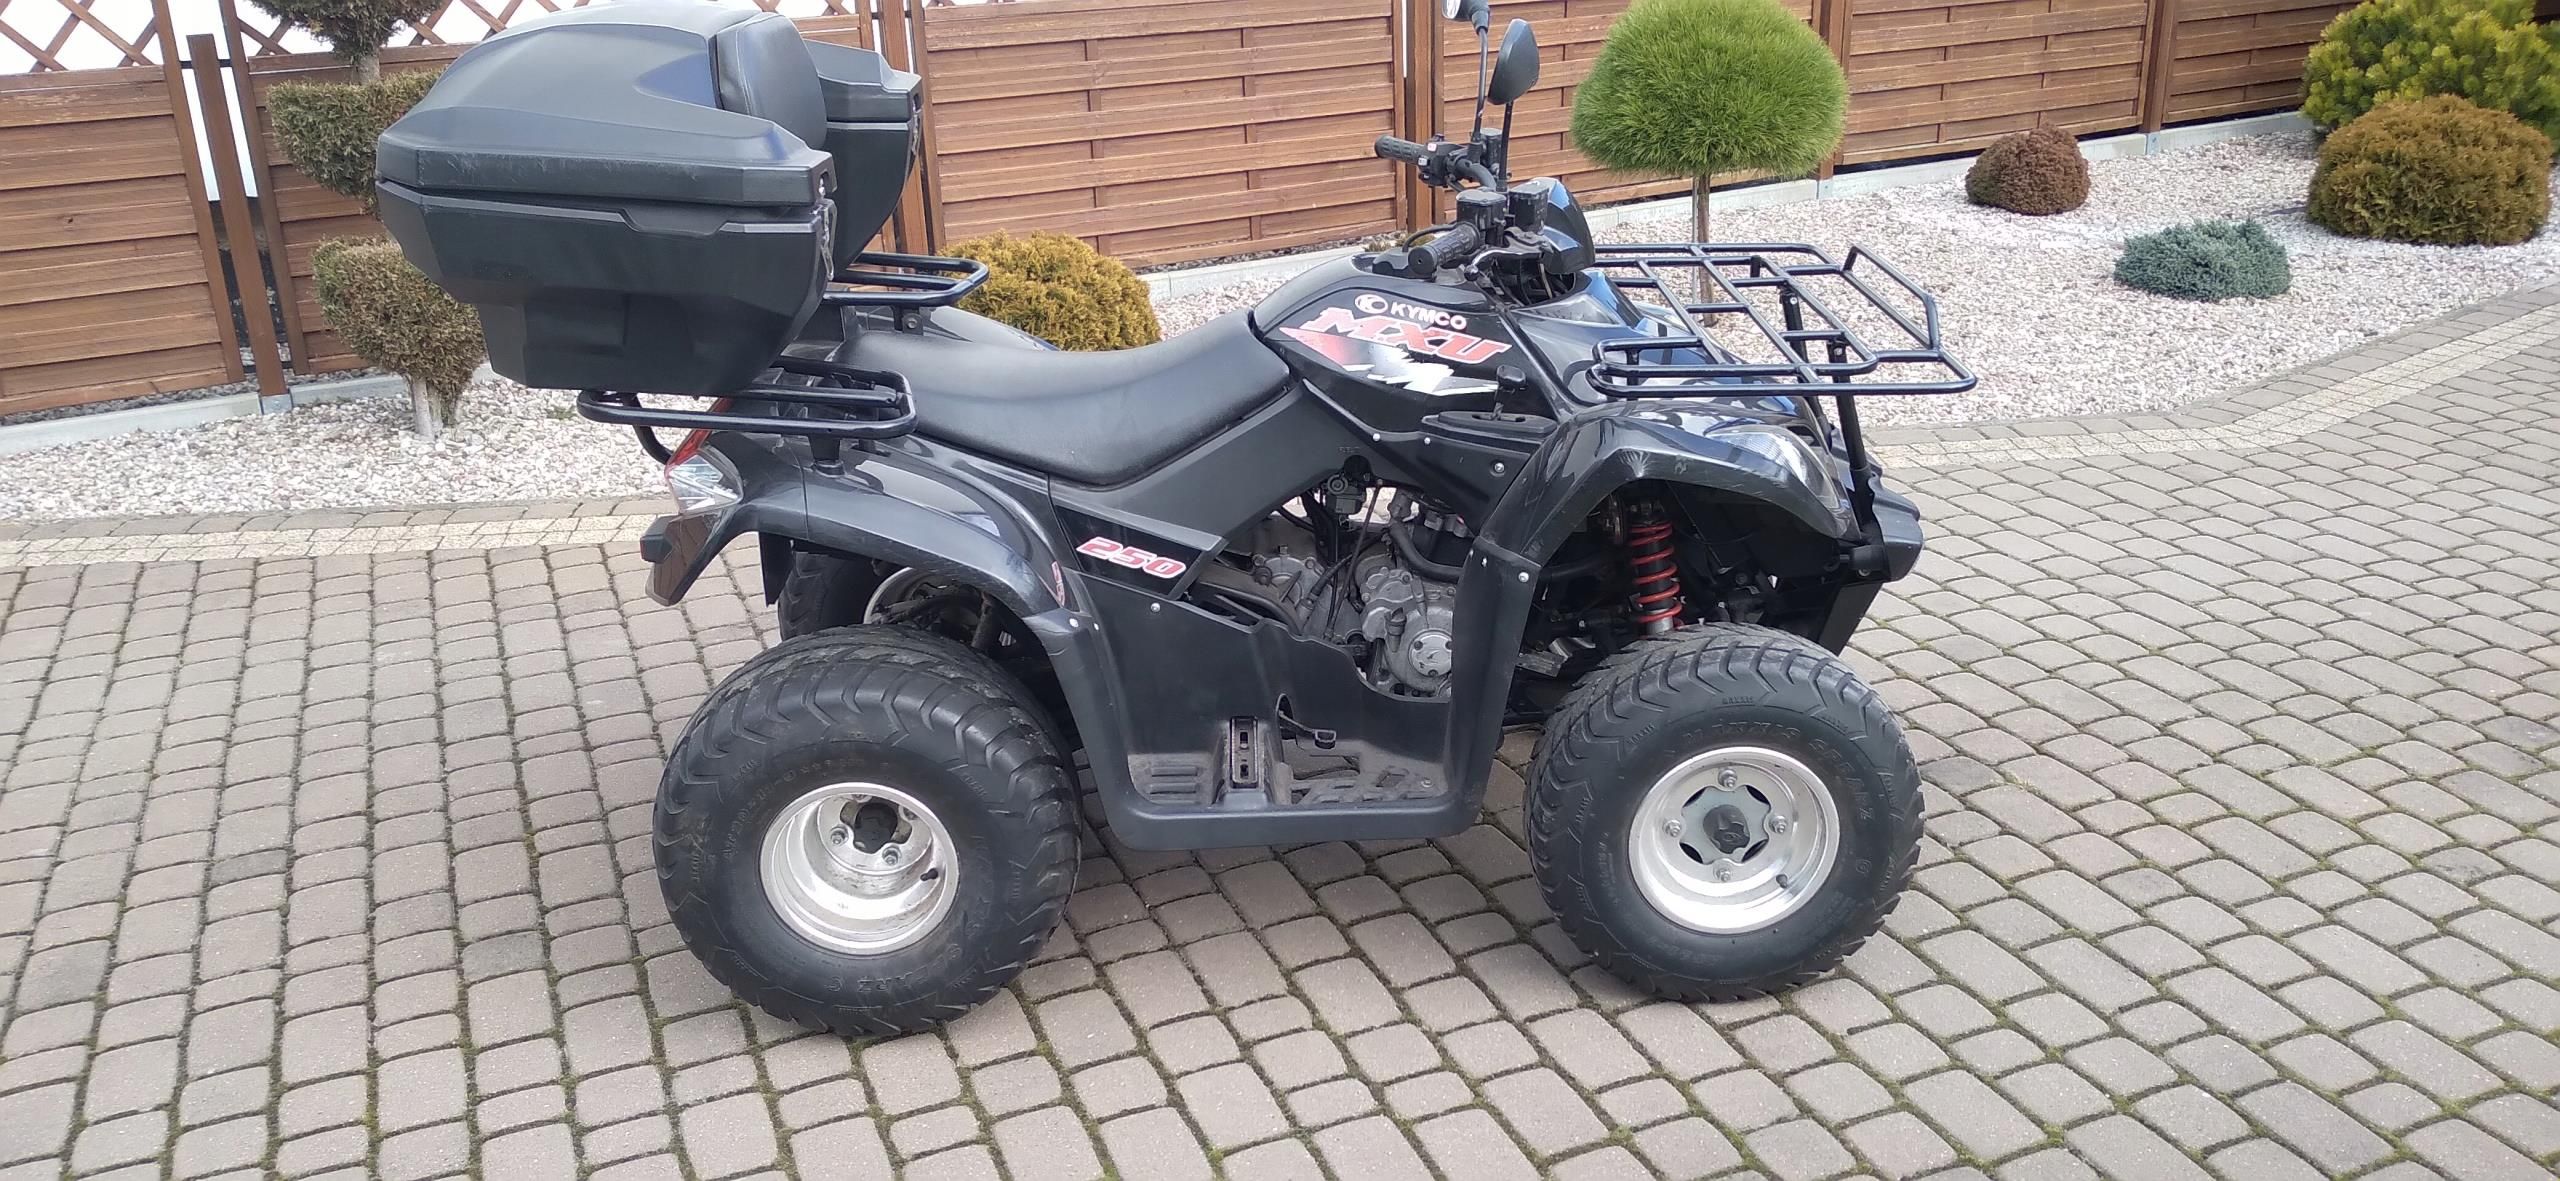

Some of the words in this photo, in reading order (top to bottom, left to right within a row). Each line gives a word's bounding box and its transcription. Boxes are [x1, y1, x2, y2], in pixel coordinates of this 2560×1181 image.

[1300, 307, 1513, 364] MXU
[1390, 301, 1467, 331] KYMCO
[1075, 536, 1187, 579] 250
